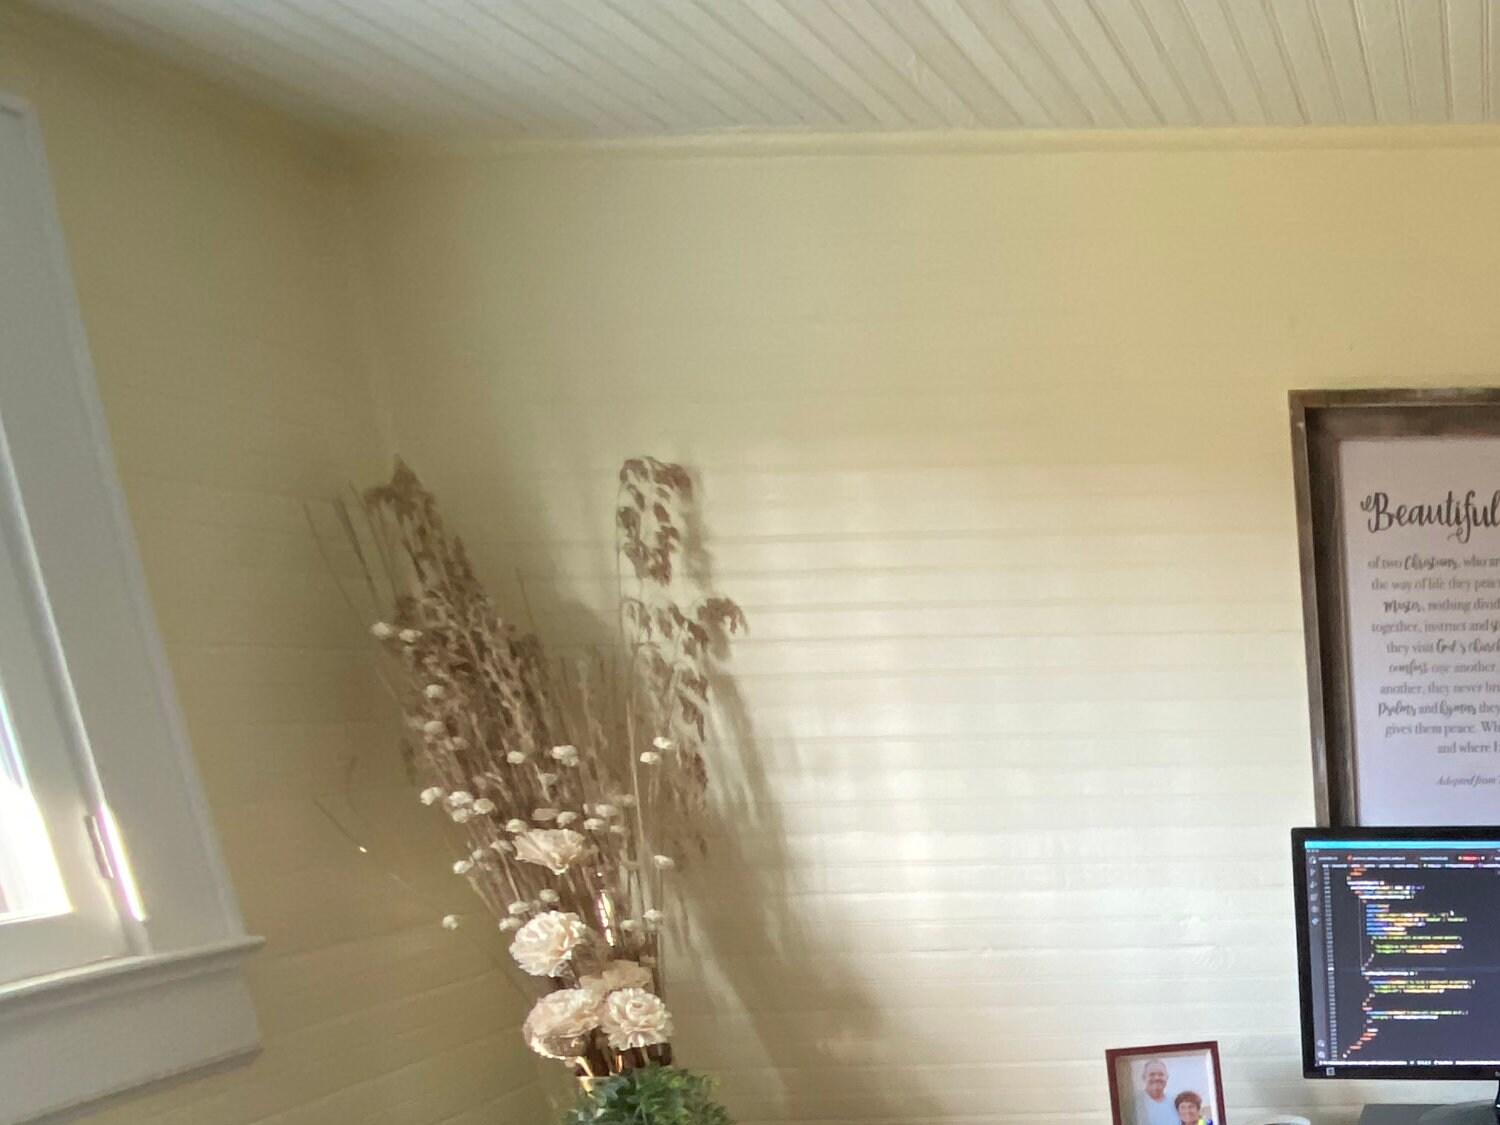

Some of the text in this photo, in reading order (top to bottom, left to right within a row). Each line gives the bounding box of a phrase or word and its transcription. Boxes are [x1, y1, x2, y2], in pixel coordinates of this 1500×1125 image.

[1368, 555, 1380, 569] of
[1381, 557, 1403, 569] two
[1463, 554, 1487, 568] who
[1371, 576, 1388, 590] the
[1391, 579, 1412, 592] way
[1414, 577, 1427, 590] of
[1448, 576, 1471, 591] they
[1428, 598, 1471, 614] nothing
[1424, 622, 1466, 632] instruct
[1469, 619, 1489, 632] and
[1386, 640, 1410, 657] they
[1430, 663, 1451, 673] one
[1428, 681, 1450, 697] they
[1452, 683, 1482, 694] never
[1418, 702, 1438, 715] and
[1384, 723, 1413, 738] gives
[1414, 722, 1442, 735] them
[1437, 741, 1457, 754] and
[1458, 740, 1491, 754] where
